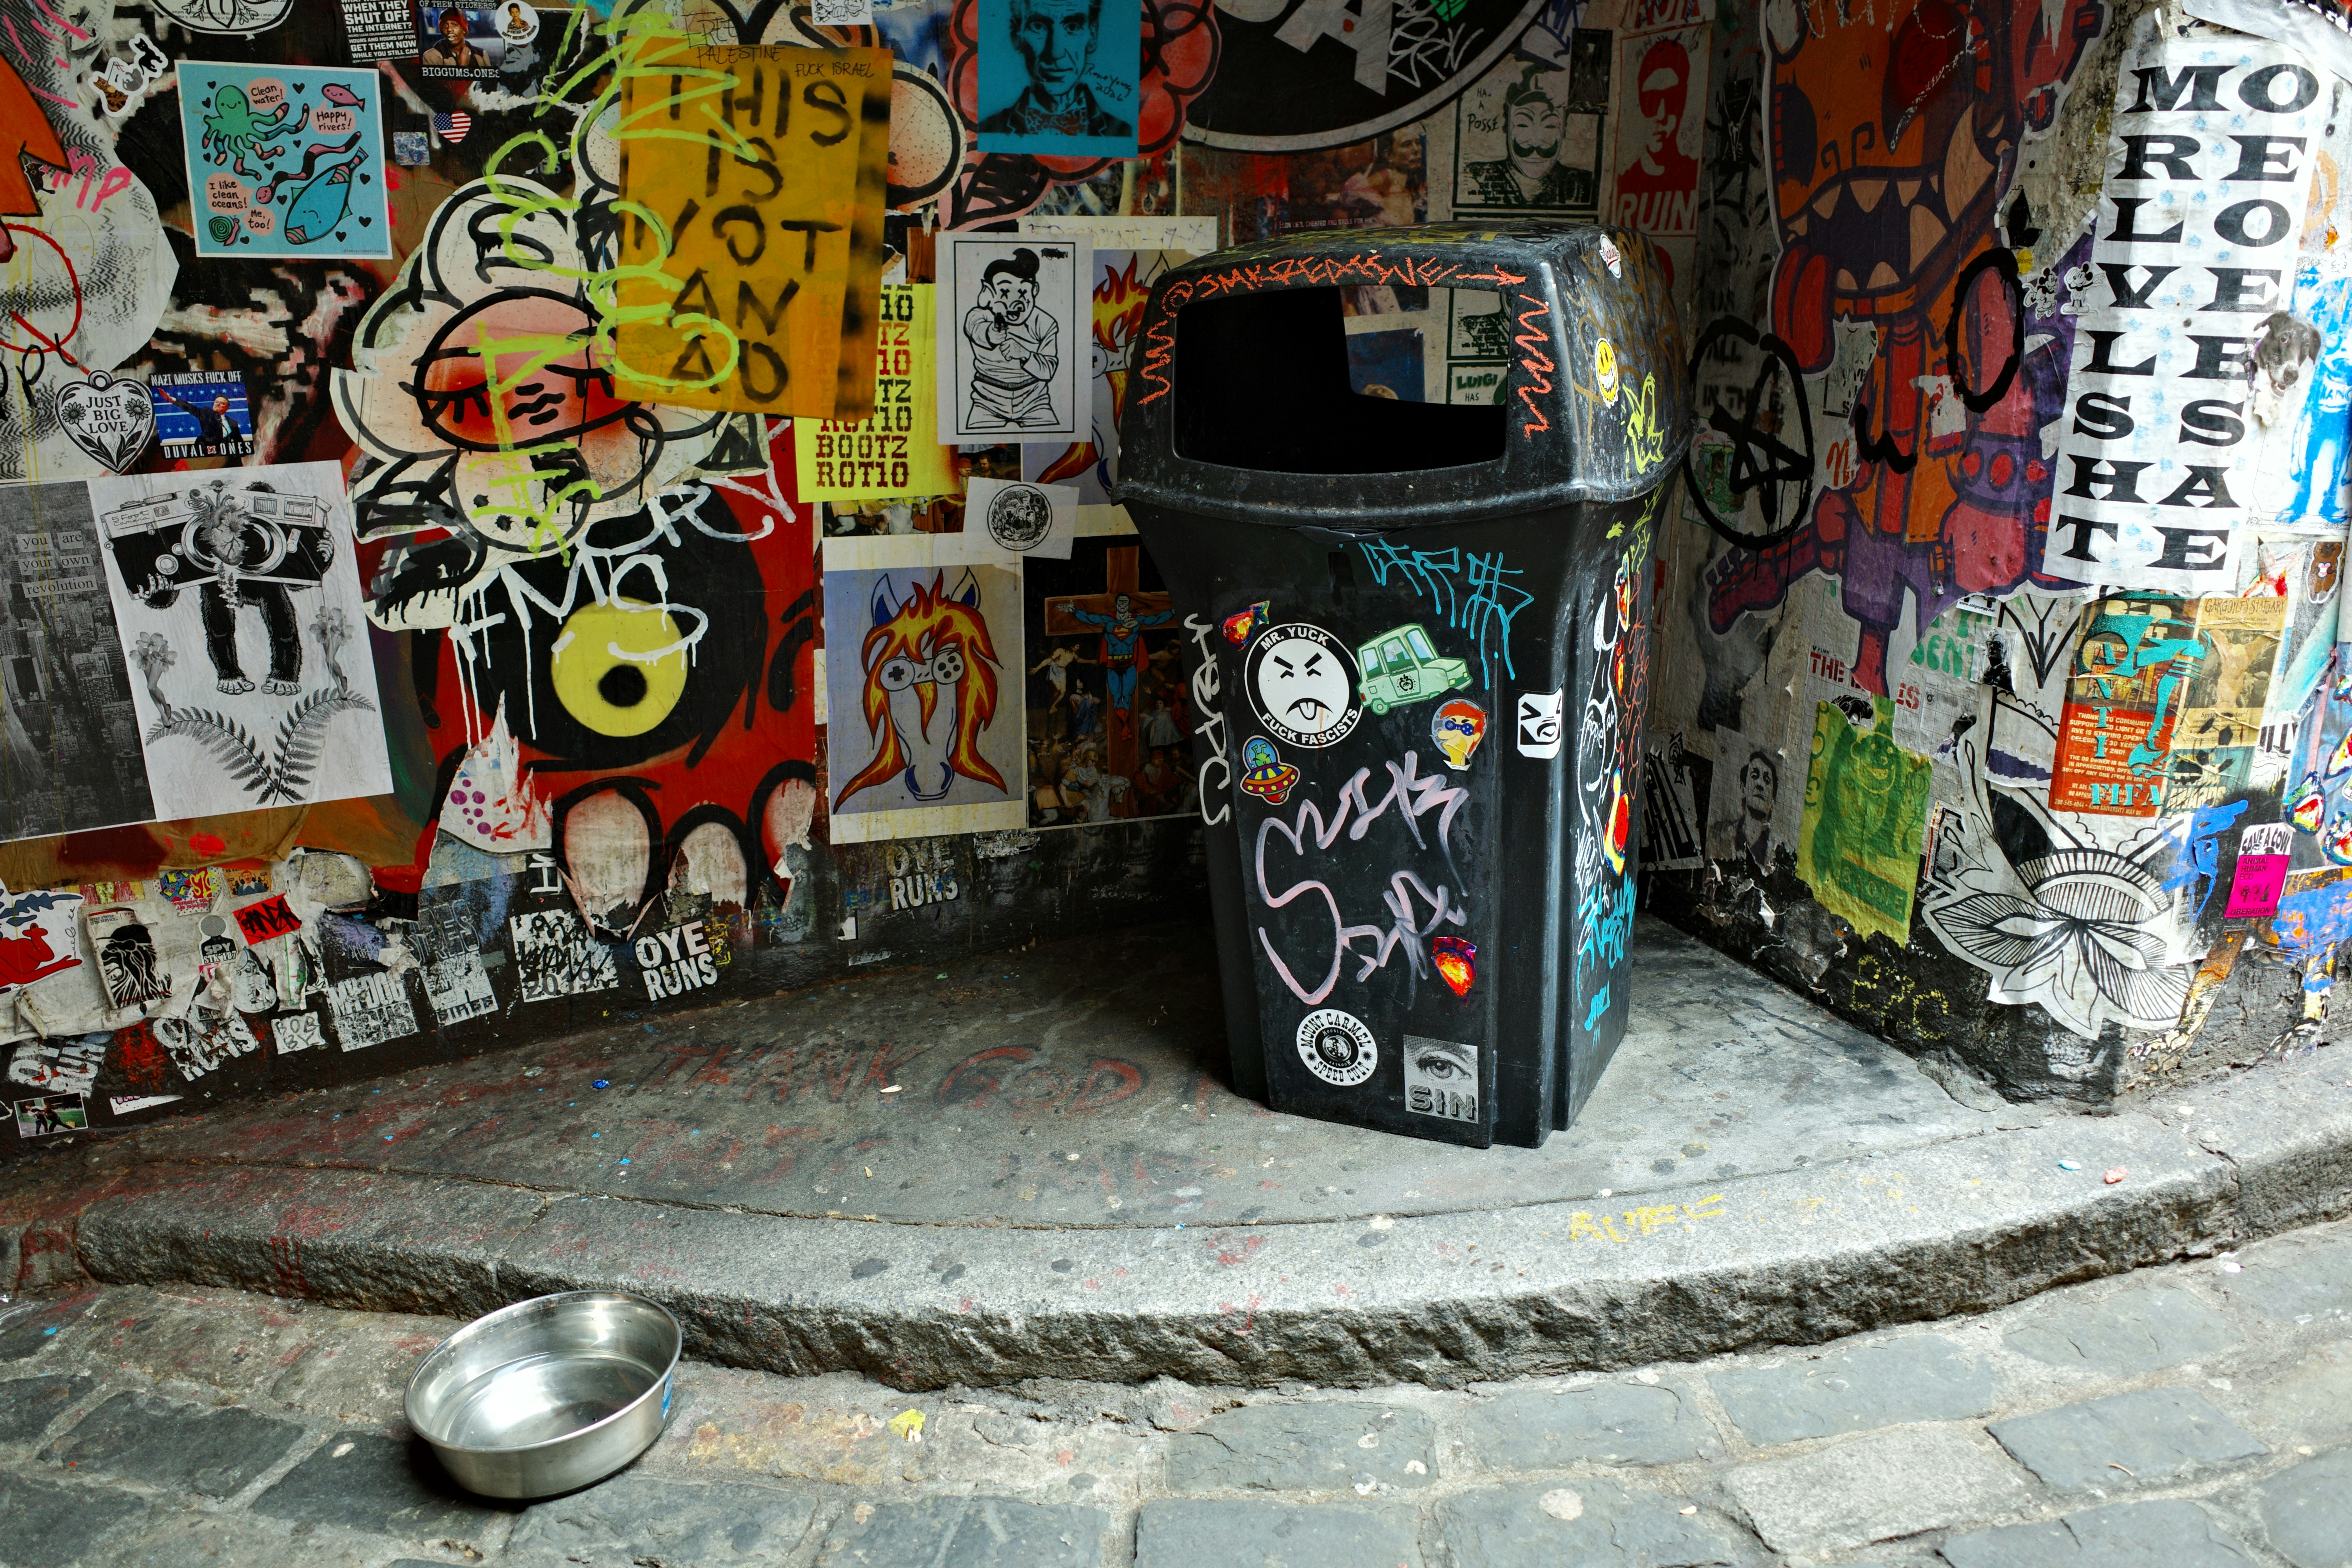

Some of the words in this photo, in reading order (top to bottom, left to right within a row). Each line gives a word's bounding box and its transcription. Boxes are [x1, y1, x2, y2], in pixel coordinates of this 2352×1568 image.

[341, 2, 377, 13] WHEN
[378, 0, 408, 11] THEY
[344, 12, 381, 25] SHUT
[384, 10, 410, 22] OFF
[346, 25, 364, 33] THE
[365, 22, 412, 32] INTERNET?
[681, 12, 739, 49] FREE
[350, 44, 367, 52] GET
[368, 42, 394, 50] THEM
[396, 40, 417, 48] NOW
[697, 46, 784, 68] PALESTINE
[795, 64, 825, 78] FUCK
[832, 62, 875, 78] ISRAEL
[251, 85, 277, 96] Clean
[253, 89, 284, 104] water!
[644, 64, 854, 147] THIS
[316, 111, 347, 123] Happy
[318, 118, 352, 131] rivers!
[1468, 113, 1501, 133] POSSE
[706, 128, 784, 203] IS
[219, 180, 237, 189] like
[212, 191, 239, 199] clean
[212, 197, 248, 208] oceans!
[251, 209, 265, 219] Me,
[248, 218, 270, 229] too!
[633, 198, 844, 273] NOT
[668, 267, 800, 336] AN
[151, 373, 173, 386] NAZI
[174, 373, 204, 385] MUSKS
[205, 372, 227, 383] FUCK
[228, 371, 242, 382] OFF
[1456, 373, 1498, 390] LUIGI
[86, 395, 122, 408] JUST
[1465, 393, 1479, 401] HAS
[94, 408, 121, 421] BIG
[88, 421, 128, 434] LOVE
[163, 444, 205, 459] DUVAL
[220, 441, 252, 455] ONES
[816, 434, 908, 459] BOOTZ
[22, 537, 48, 549] you
[63, 534, 82, 544] are
[22, 558, 53, 572] your
[62, 556, 89, 566] own
[27, 578, 94, 595] revolution
[1959, 600, 1996, 613] www.oldgrumpy.net
[1260, 632, 1284, 650] MR.
[1286, 627, 1329, 646] YUCK
[1817, 647, 1830, 655] VLMK
[1810, 652, 1845, 682] THE
[1896, 682, 1920, 710] IS
[1262, 712, 1298, 742] FUCK
[1301, 708, 1357, 744] FASCISTS
[2093, 730, 2121, 739] STAYING
[2091, 783, 2163, 806] FIFA
[2100, 805, 2125, 813] UNIVERSITY
[2241, 828, 2262, 855] SAVE
[2264, 826, 2271, 846] A
[2272, 826, 2291, 854] COW
[2230, 907, 2271, 915] LIBERATION
[203, 943, 231, 955] SPY
[635, 920, 710, 968] OYE
[524, 967, 595, 1000] 2019
[642, 953, 719, 1001] RUNS
[360, 971, 407, 1009] DOG
[1300, 1014, 1325, 1048] MOUNT
[1326, 1013, 1372, 1047] CARMEL
[1313, 1061, 1344, 1082] SPEED
[1346, 1061, 1370, 1082] CULT
[1408, 1084, 1477, 1121] SIN
